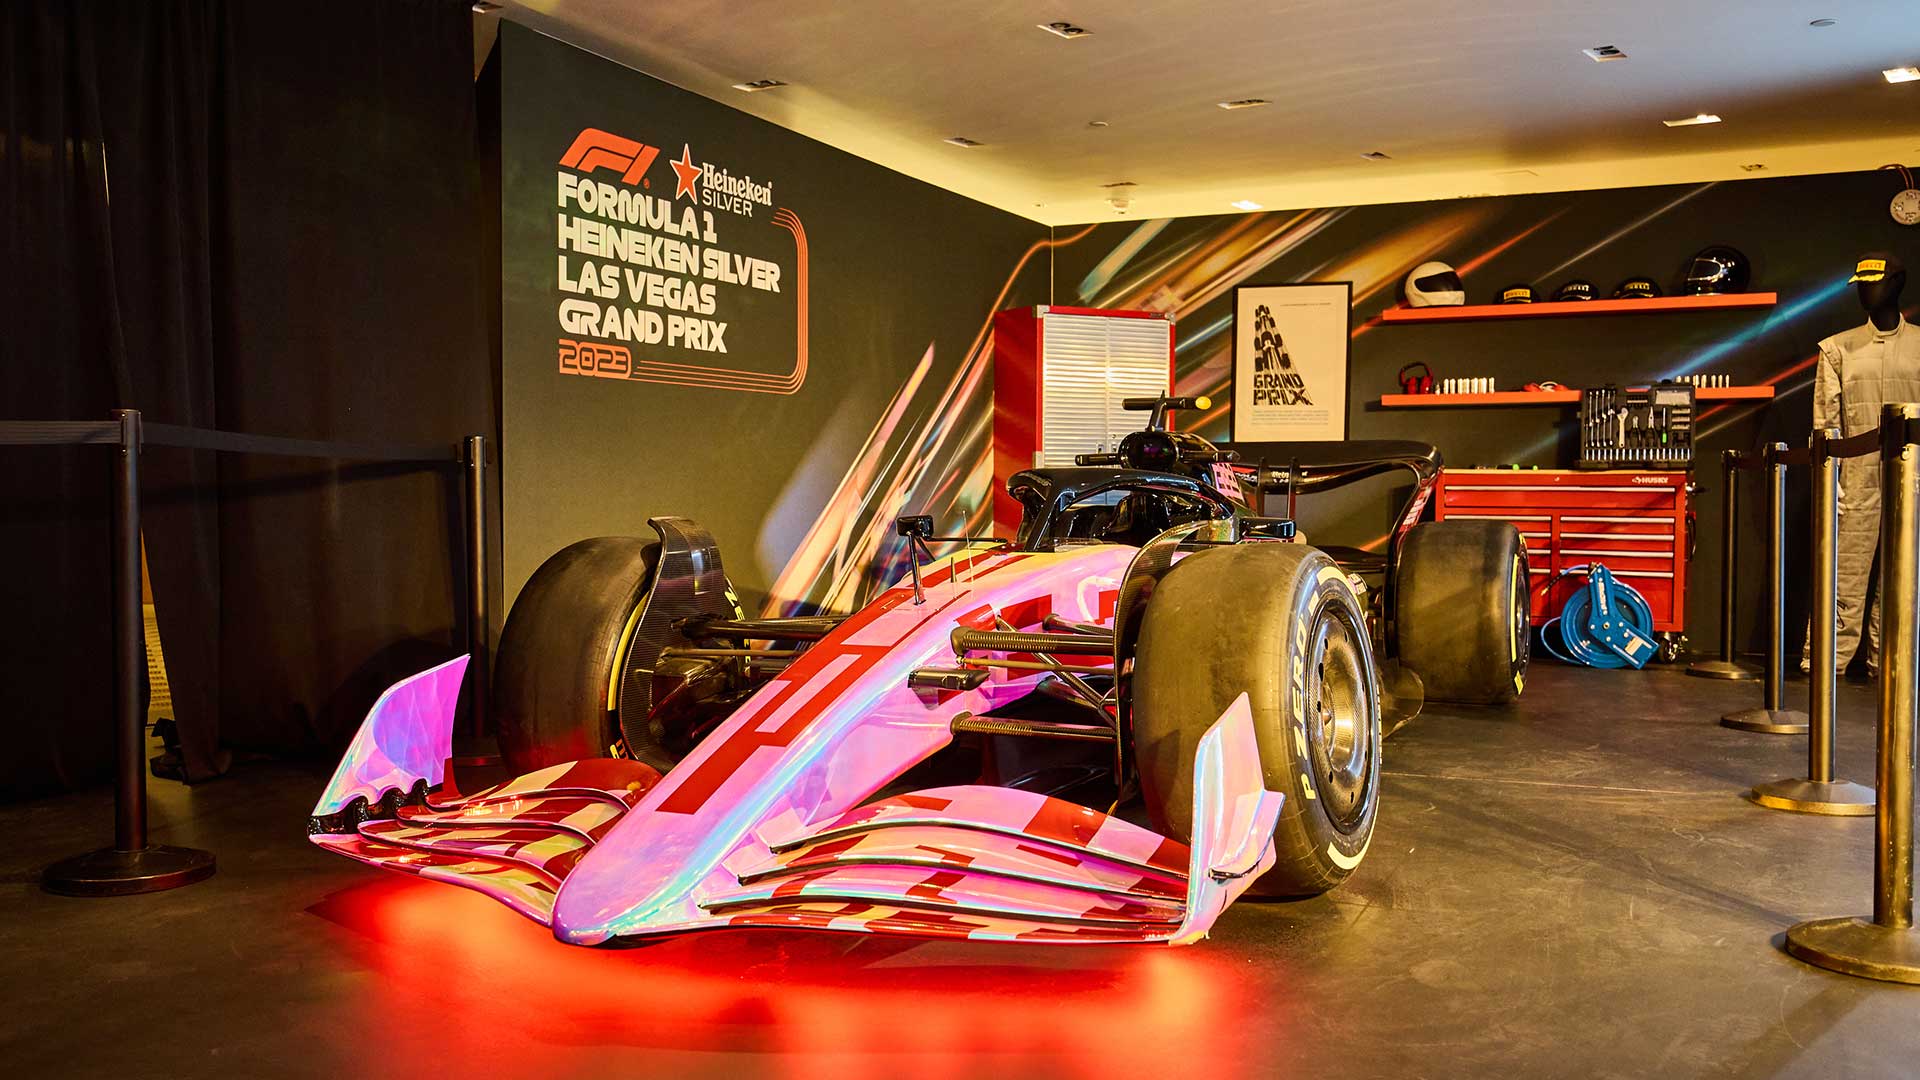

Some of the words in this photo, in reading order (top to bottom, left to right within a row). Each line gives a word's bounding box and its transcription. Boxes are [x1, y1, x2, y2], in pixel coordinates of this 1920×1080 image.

[702, 163, 773, 206] Heineken
[702, 189, 753, 217] SILVER
[557, 171, 700, 240] FORMULA
[702, 211, 718, 244] 1
[557, 214, 700, 276] HEINEKEN
[702, 248, 781, 293] SILVER
[558, 255, 620, 300] LAS
[624, 267, 717, 316] VEGAS
[558, 298, 664, 344] GRAND
[667, 314, 728, 354] PRIX
[558, 338, 632, 379] 2023
[1253, 373, 1305, 389] GRAND
[1253, 388, 1314, 406] PRIX
[1642, 476, 1669, 484] HUSKY
[1292, 617, 1308, 761] ZERO
[1300, 773, 1316, 799] P
